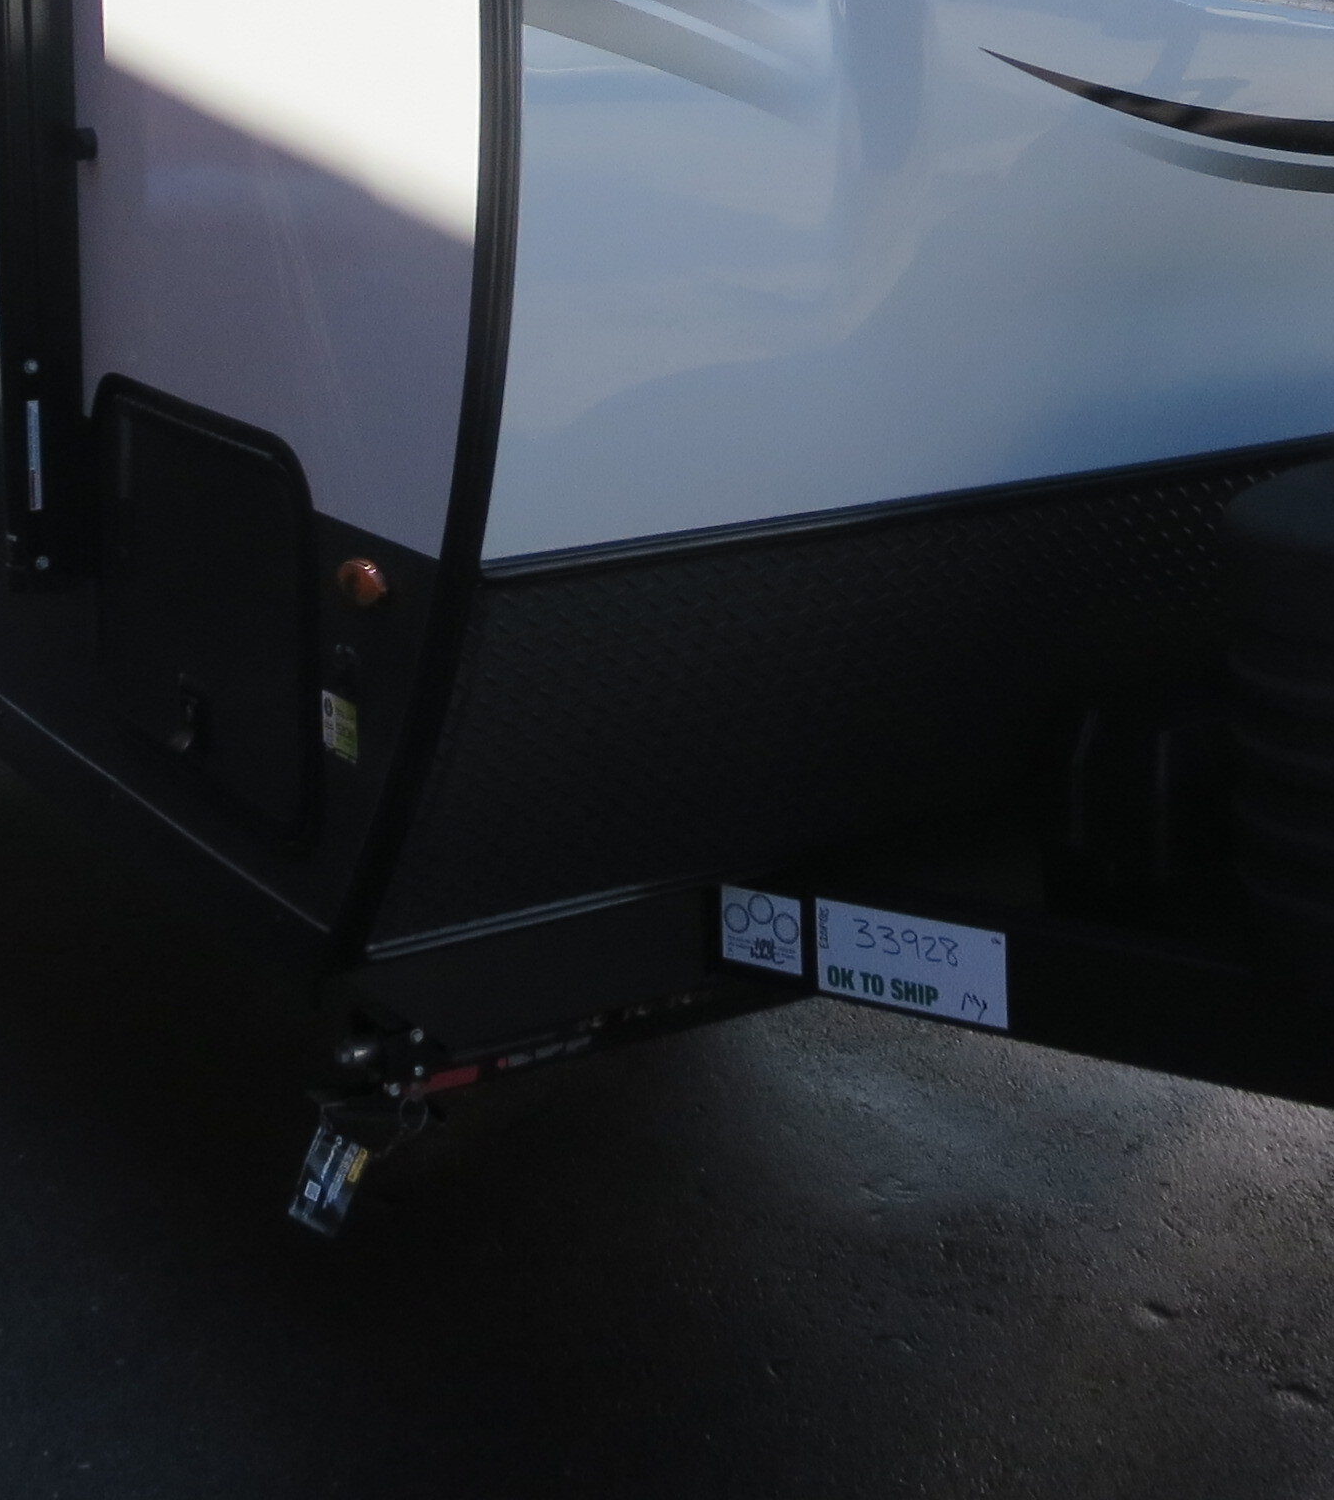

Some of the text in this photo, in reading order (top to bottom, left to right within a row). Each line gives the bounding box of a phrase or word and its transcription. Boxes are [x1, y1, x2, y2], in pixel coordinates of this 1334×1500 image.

[852, 918, 959, 967] 33928
[827, 965, 939, 1007] OK TO SHIP
